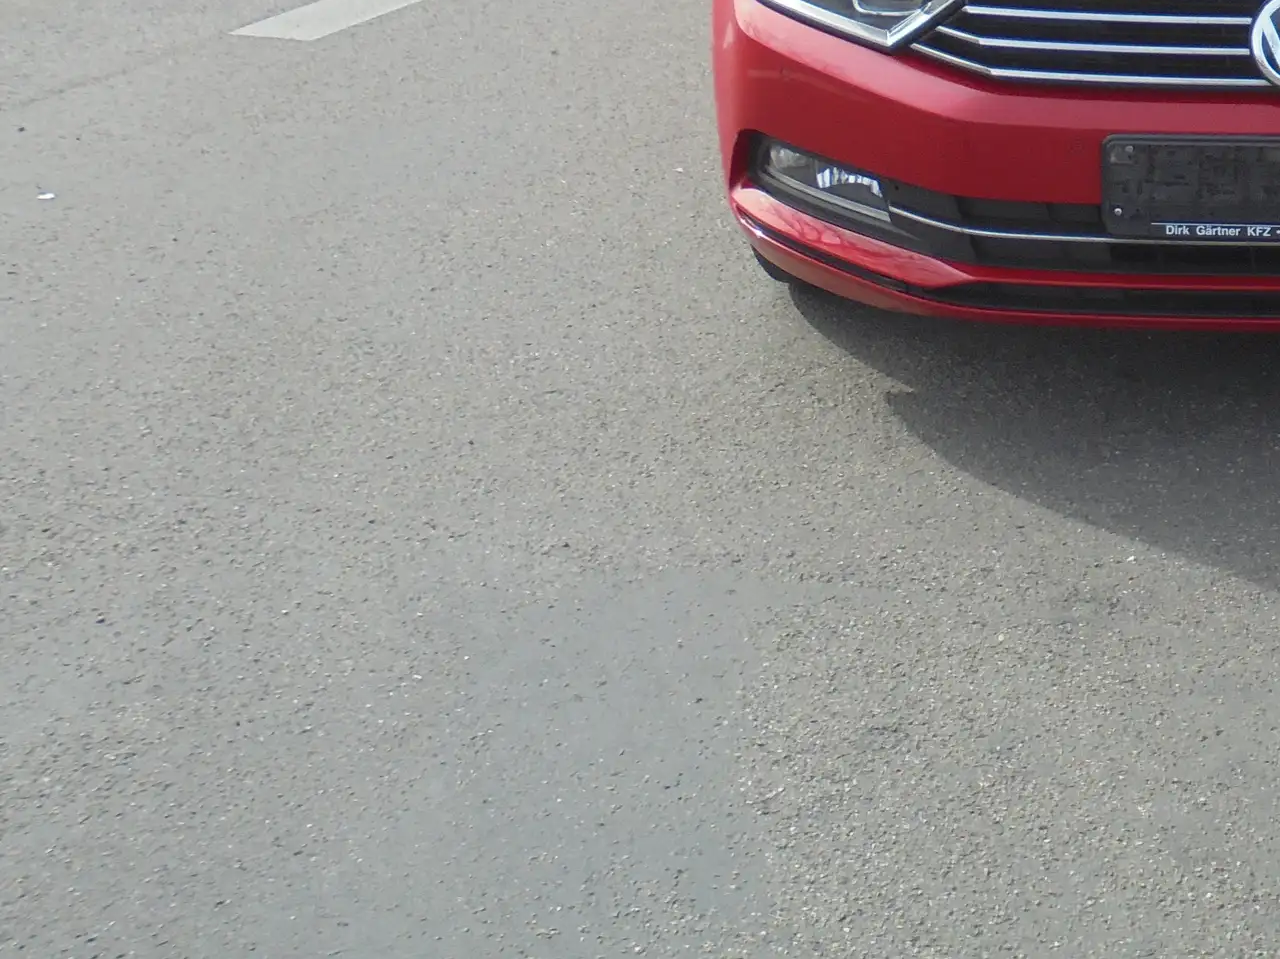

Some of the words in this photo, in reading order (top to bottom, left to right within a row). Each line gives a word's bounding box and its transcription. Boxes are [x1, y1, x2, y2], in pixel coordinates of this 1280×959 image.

[1165, 225, 1190, 235] Dirk
[1196, 224, 1241, 236] Gärtner
[1247, 226, 1272, 237] KFZ
